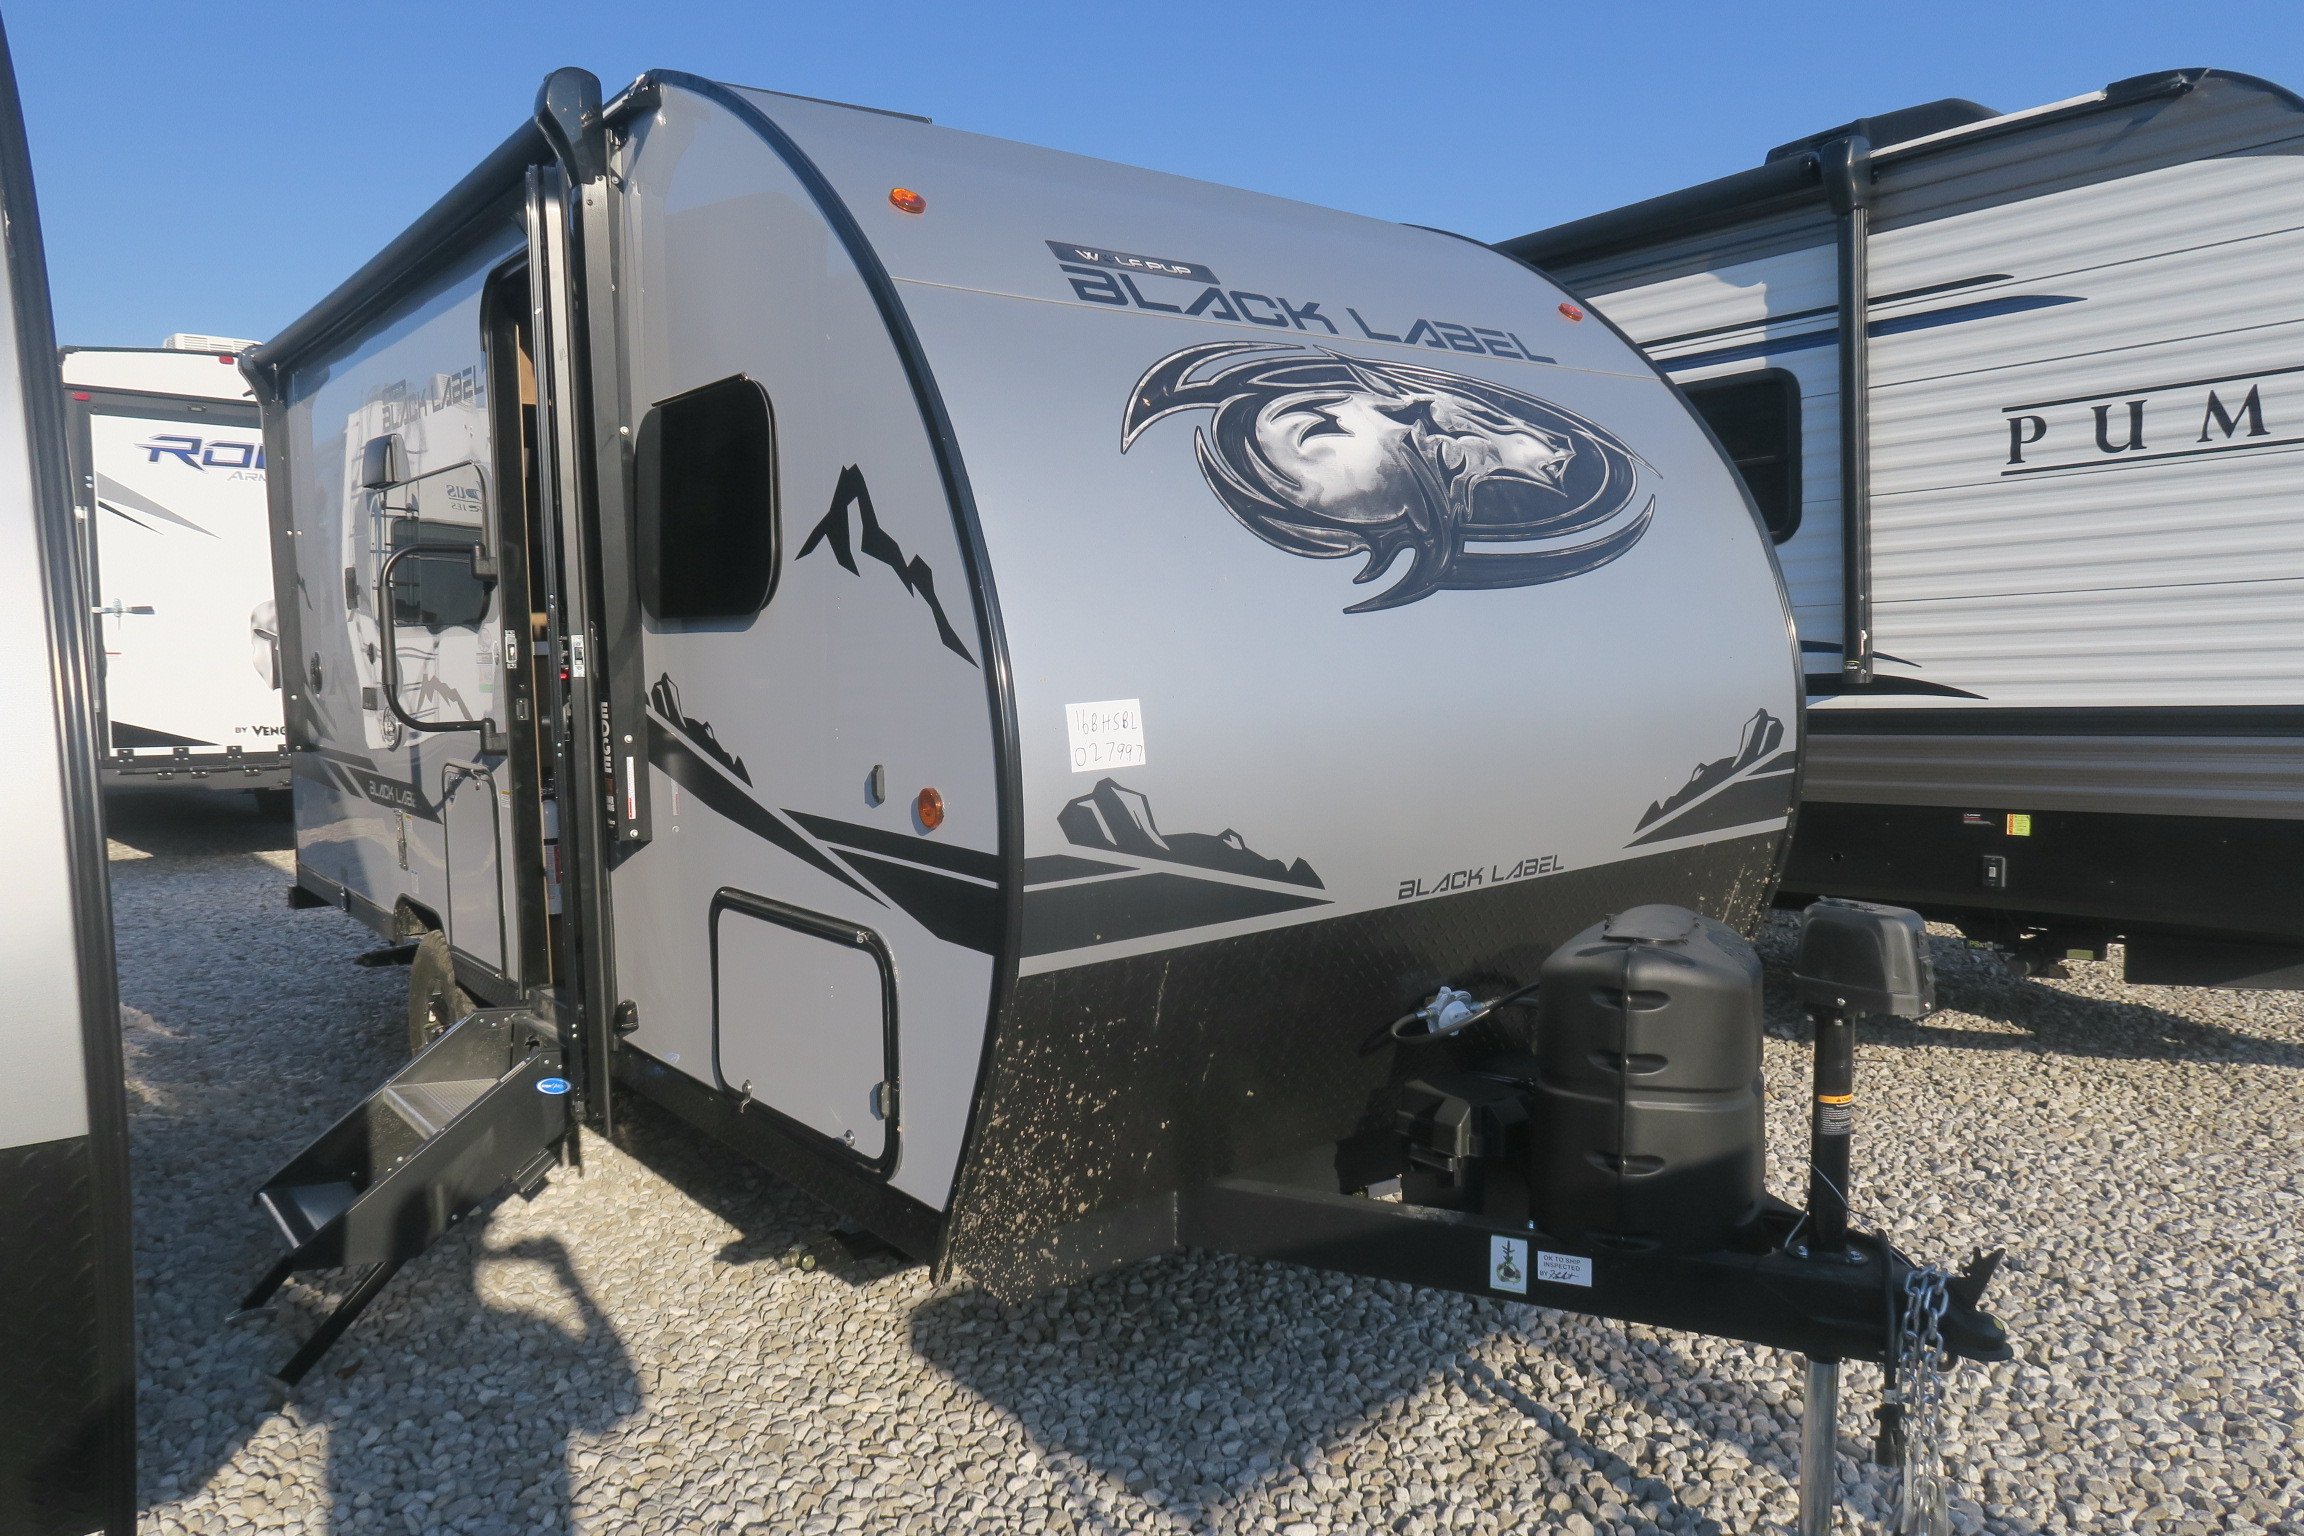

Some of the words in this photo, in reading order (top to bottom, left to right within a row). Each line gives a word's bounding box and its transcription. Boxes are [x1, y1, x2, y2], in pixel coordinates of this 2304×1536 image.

[1144, 261, 1192, 275] PUP
[1059, 264, 1339, 335] BLACK
[1346, 307, 1558, 365] LABEL
[431, 365, 484, 413] LABEL
[2006, 384, 2271, 465] PUM
[235, 726, 248, 734] BY
[1075, 708, 1138, 735] 16BHSBL
[1074, 741, 1144, 767] 027997
[1397, 866, 1485, 901] BLACK
[1491, 854, 1565, 883] LABEL
[1543, 1261, 1581, 1272] INSPECTED
